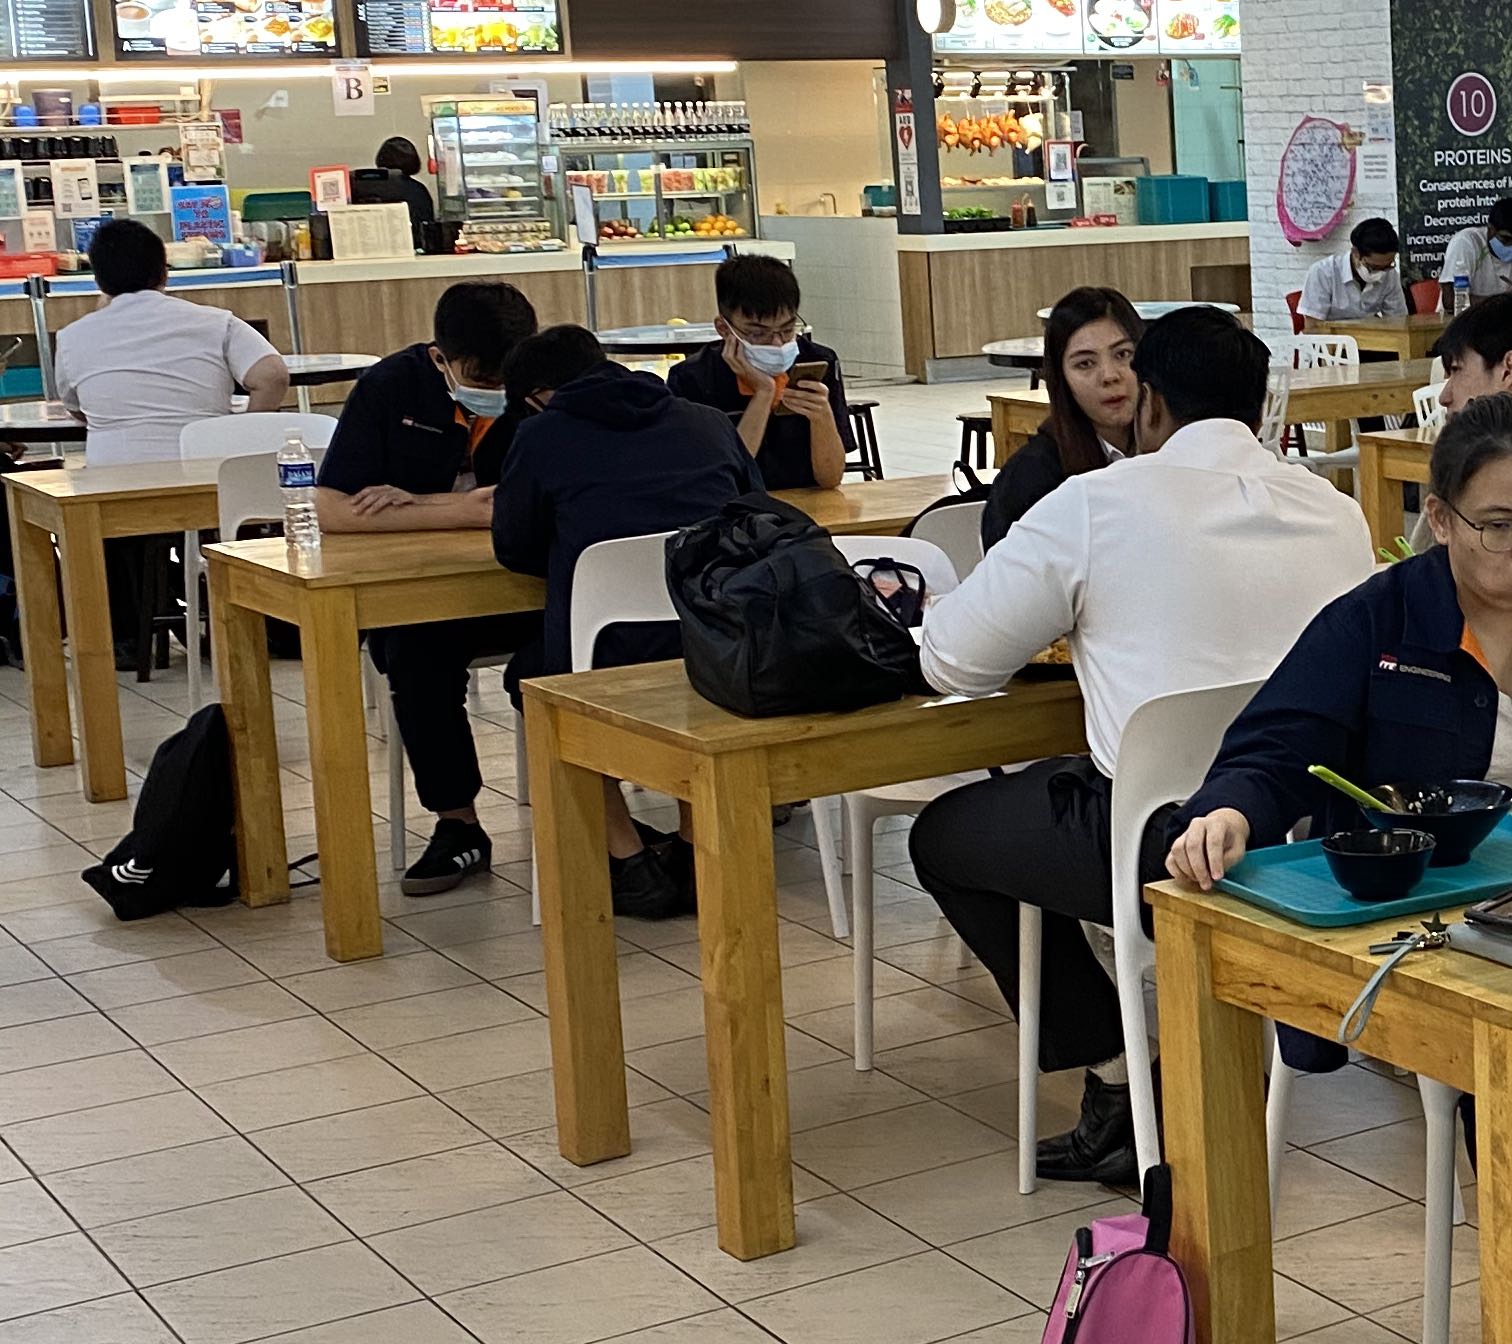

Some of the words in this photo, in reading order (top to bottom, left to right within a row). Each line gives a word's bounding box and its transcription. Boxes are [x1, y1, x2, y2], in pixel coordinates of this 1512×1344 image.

[343, 77, 363, 100] B
[1459, 89, 1486, 118] 10
[1434, 148, 1512, 167] PROTEINS
[1420, 179, 1495, 193] Consequences
[1496, 176, 1507, 188] of
[1437, 196, 1476, 212] protein
[1424, 213, 1481, 227] Decreased
